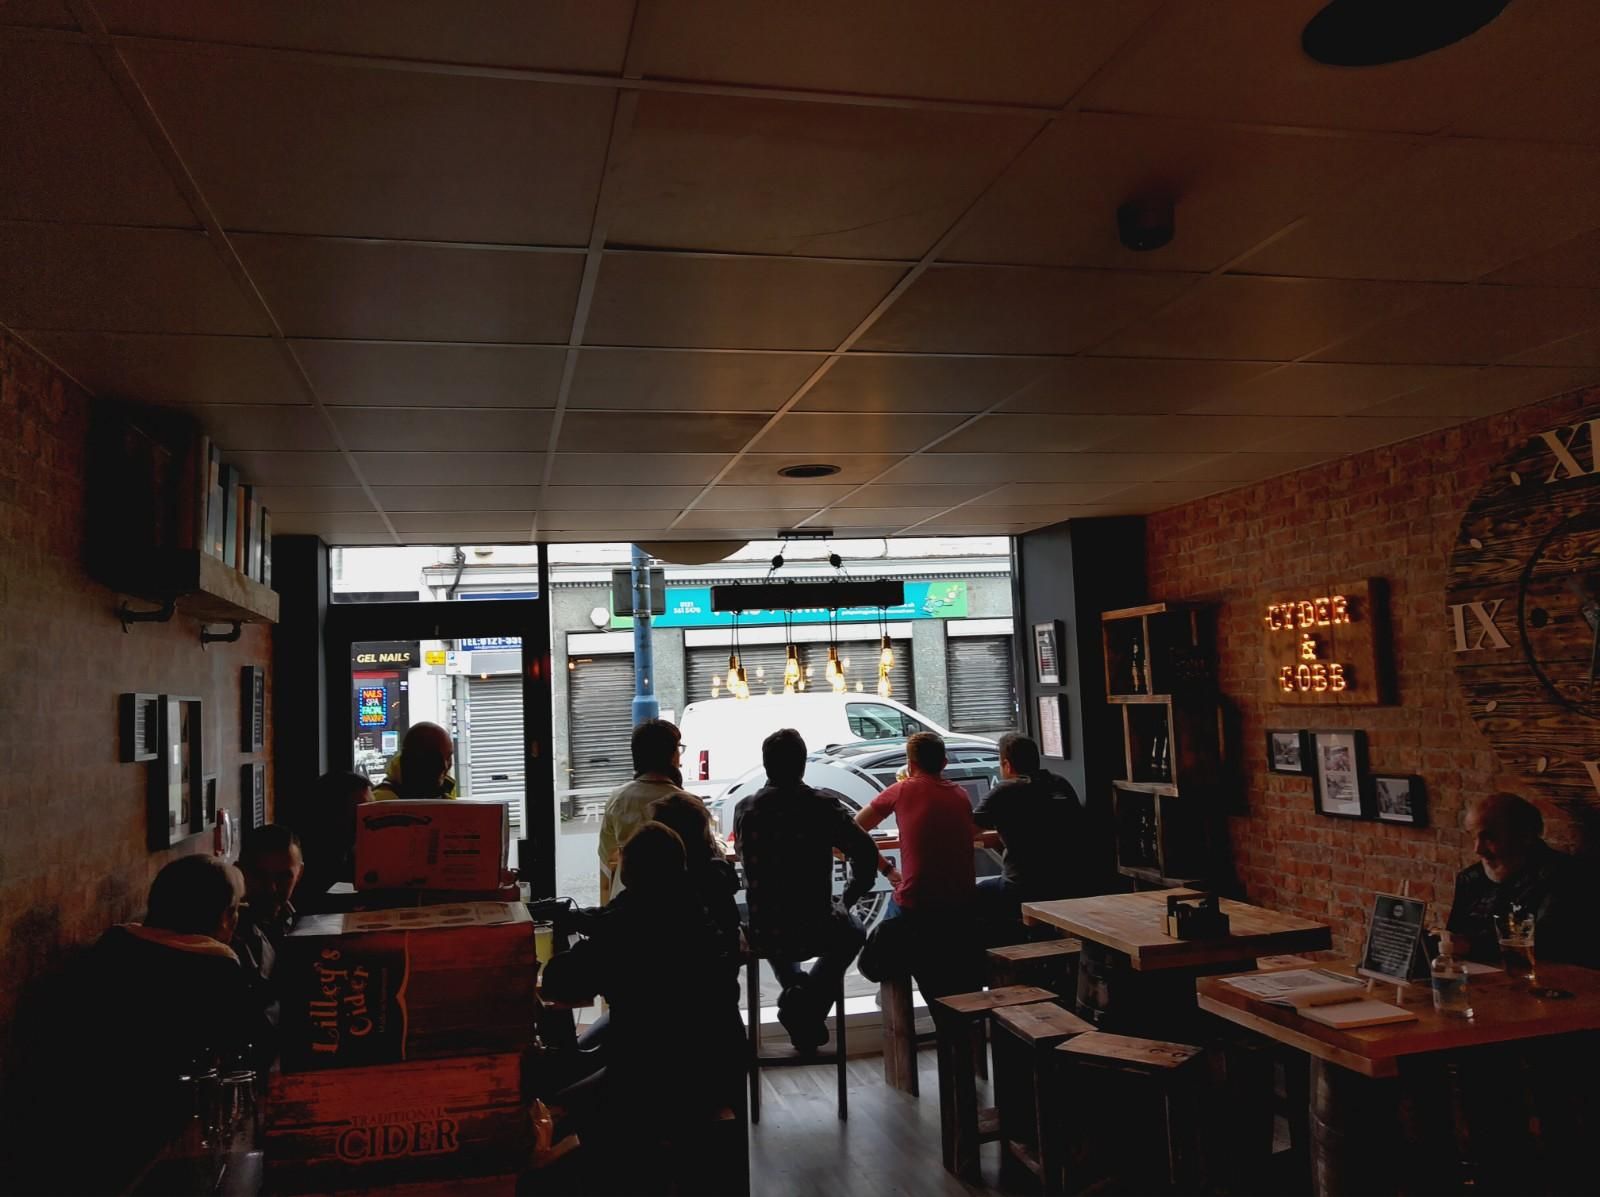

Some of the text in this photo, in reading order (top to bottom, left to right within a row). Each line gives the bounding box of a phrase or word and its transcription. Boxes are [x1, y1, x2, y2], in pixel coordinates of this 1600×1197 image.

[1265, 595, 1350, 630] CYDER
[1450, 598, 1511, 653] IX
[356, 652, 411, 663] GEL NAILS
[1301, 633, 1316, 660] &
[1280, 664, 1346, 691] COBB
[362, 689, 383, 698] NAILS
[365, 698, 380, 706] SPA
[309, 948, 347, 1055] Lilley's
[344, 965, 373, 1037] Cider
[351, 1107, 448, 1127] TRADITIONAL
[337, 1118, 459, 1161] CIDER
